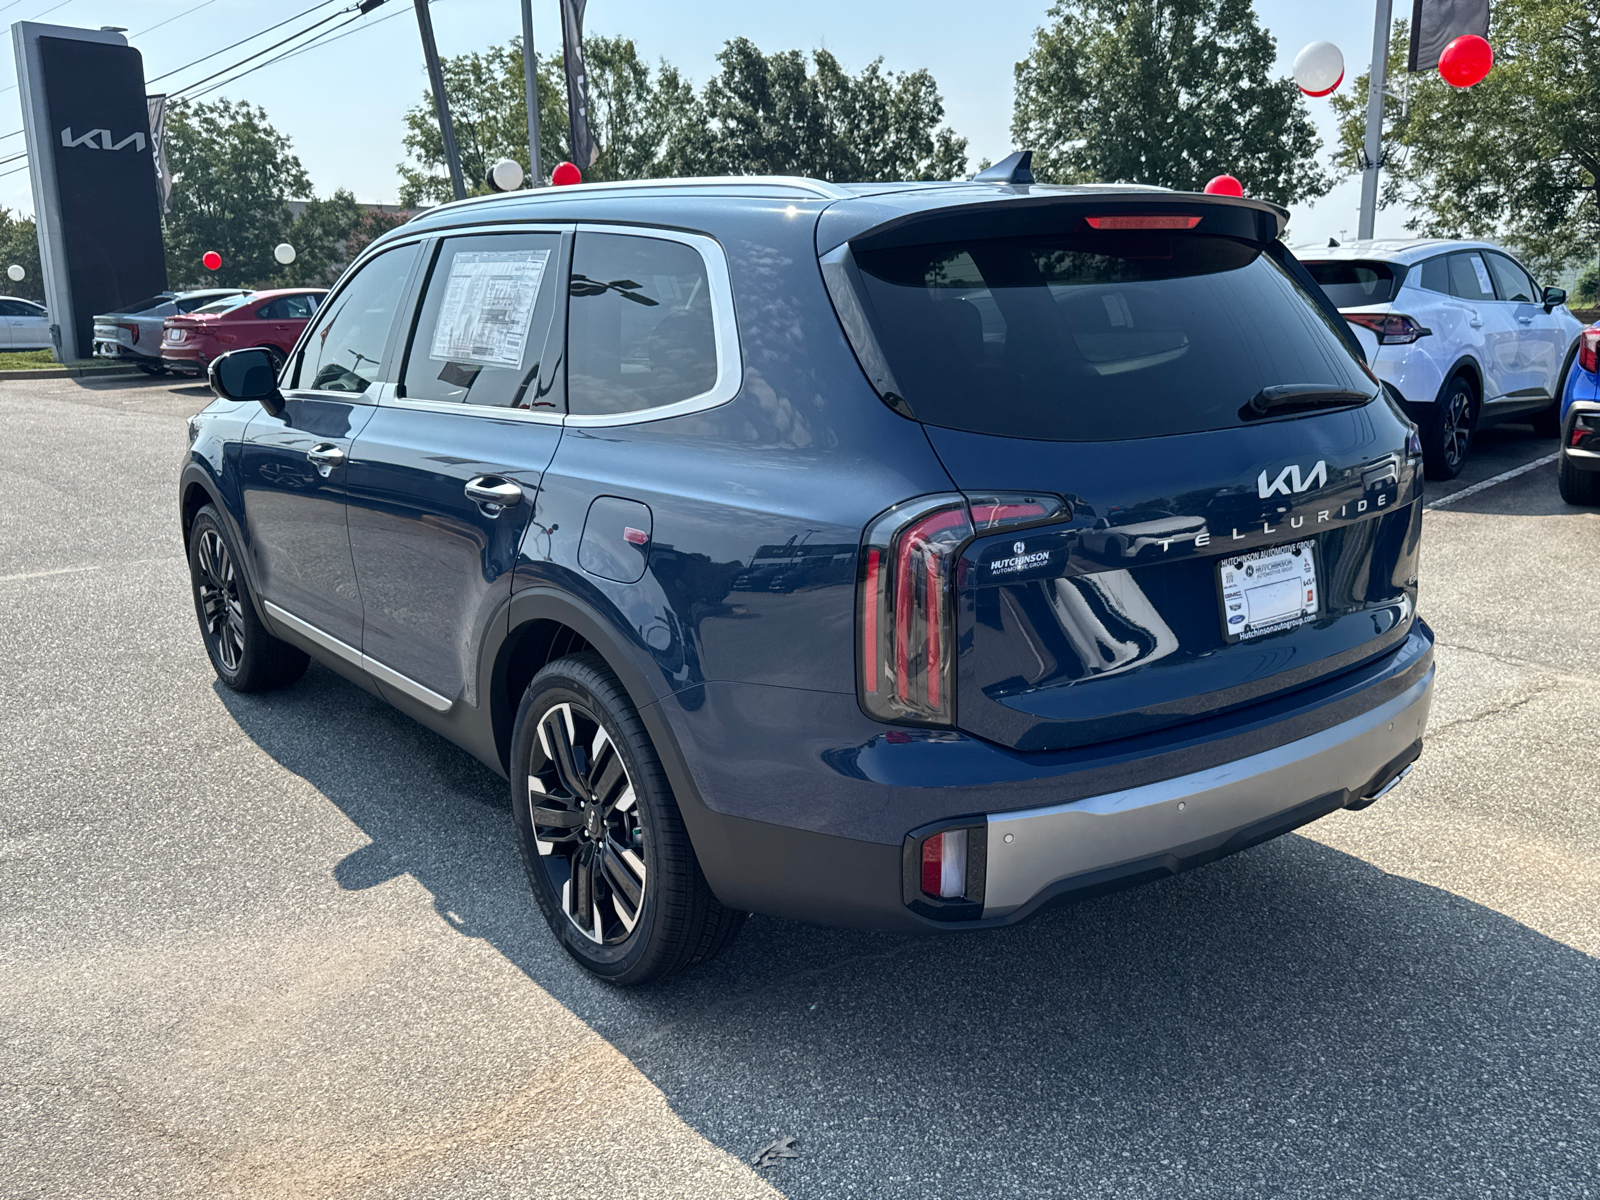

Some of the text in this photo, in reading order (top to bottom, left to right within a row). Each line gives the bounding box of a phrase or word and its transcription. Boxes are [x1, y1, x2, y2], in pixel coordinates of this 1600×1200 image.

[61, 127, 146, 152] KIA
[1257, 460, 1328, 499] KIA
[1157, 494, 1386, 552] TELLURIDE
[991, 551, 1050, 570] HUTCHINSON
[1029, 560, 1048, 569] GROUP
[1221, 539, 1316, 568] HUTCHINSON AUTOMOTIVE GROUP
[1255, 558, 1293, 574] HUTCHINSON
[1239, 614, 1317, 640] Hutchinsonautogroup.com
